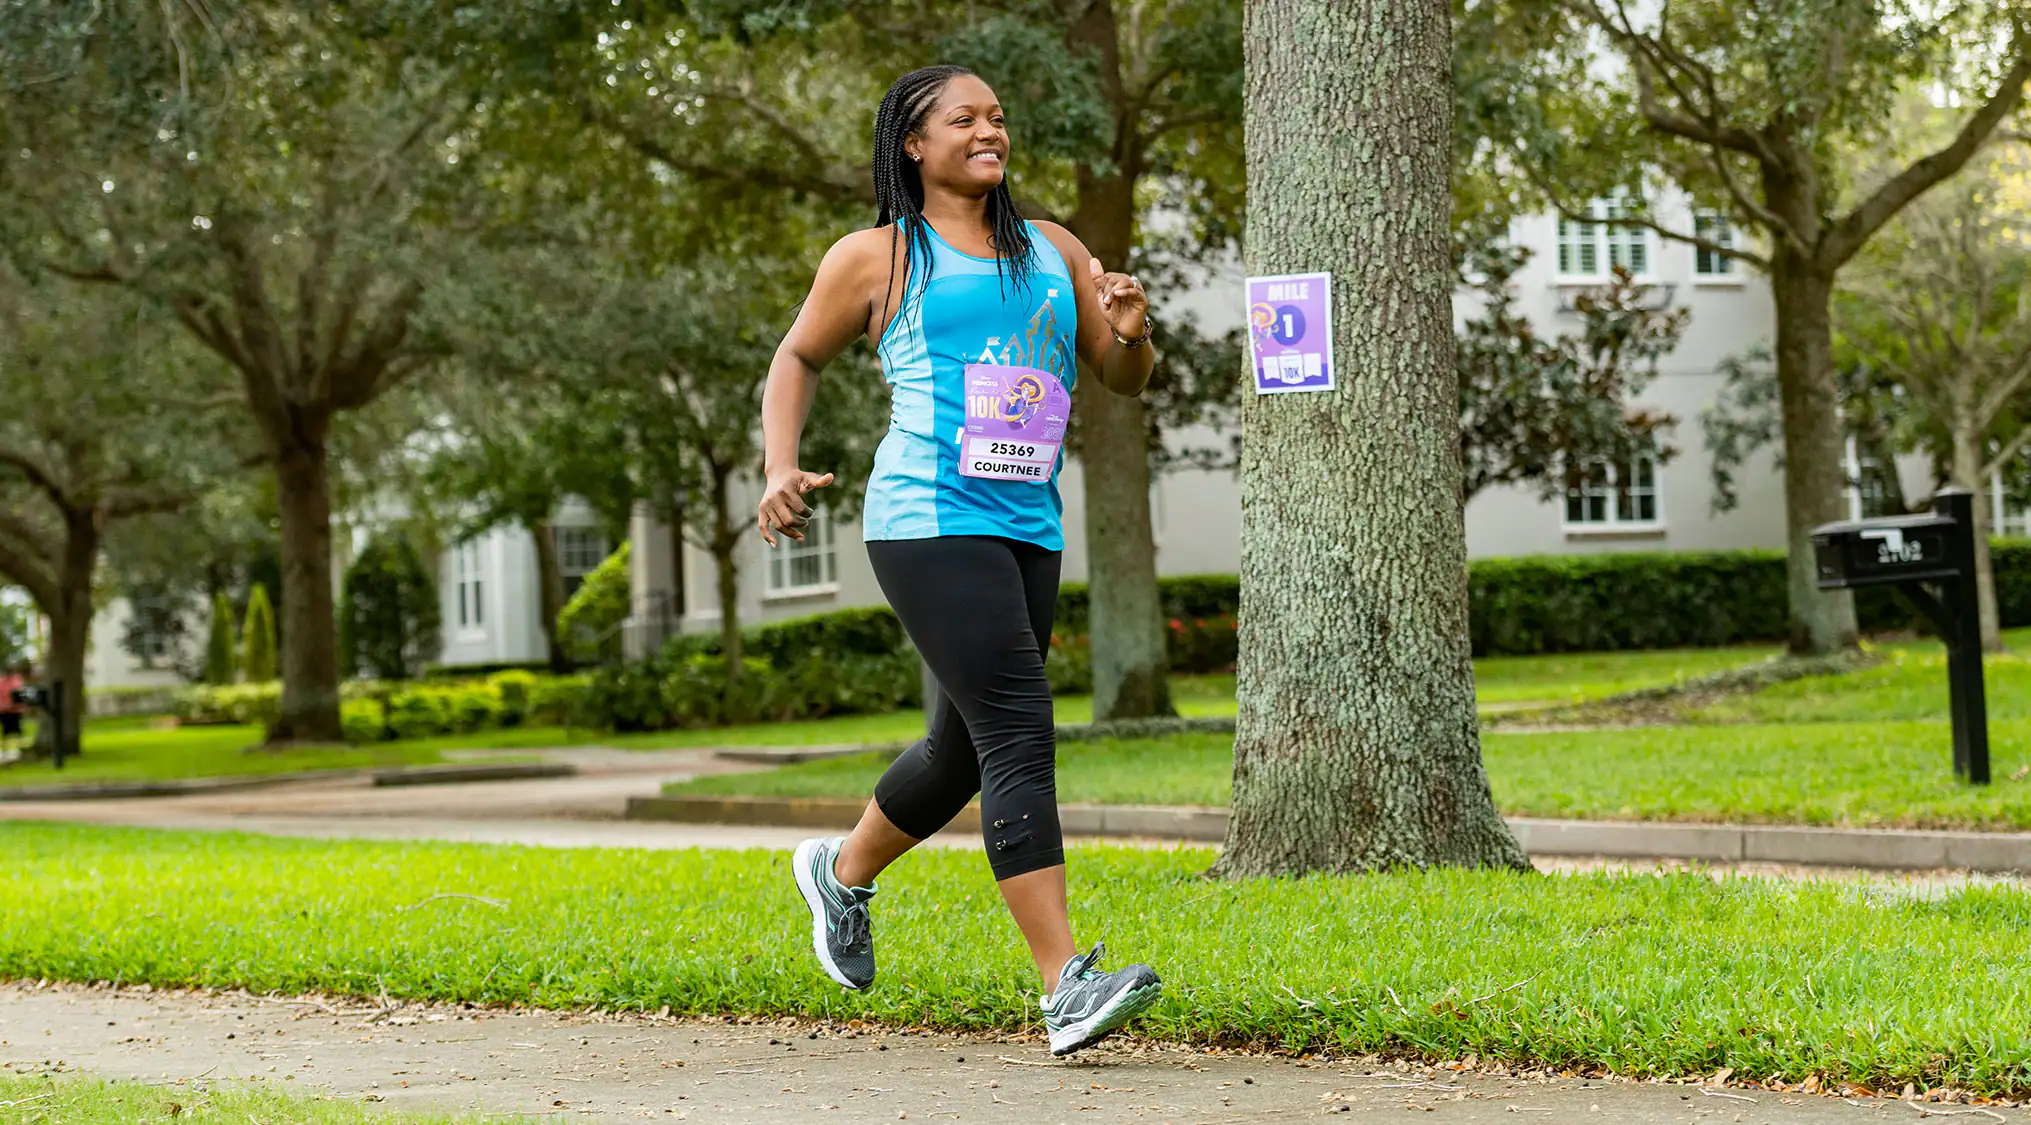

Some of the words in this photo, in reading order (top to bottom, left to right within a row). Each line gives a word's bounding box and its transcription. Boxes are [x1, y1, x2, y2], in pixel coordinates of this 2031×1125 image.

[1268, 283, 1309, 301] MILE
[1282, 314, 1294, 338] 1
[1283, 366, 1300, 379] 10K
[1052, 382, 1062, 394] A
[967, 395, 1001, 420] 10K
[990, 443, 1035, 457] 25369
[974, 461, 1041, 476] COURTNEE
[1878, 540, 1923, 563] 202
